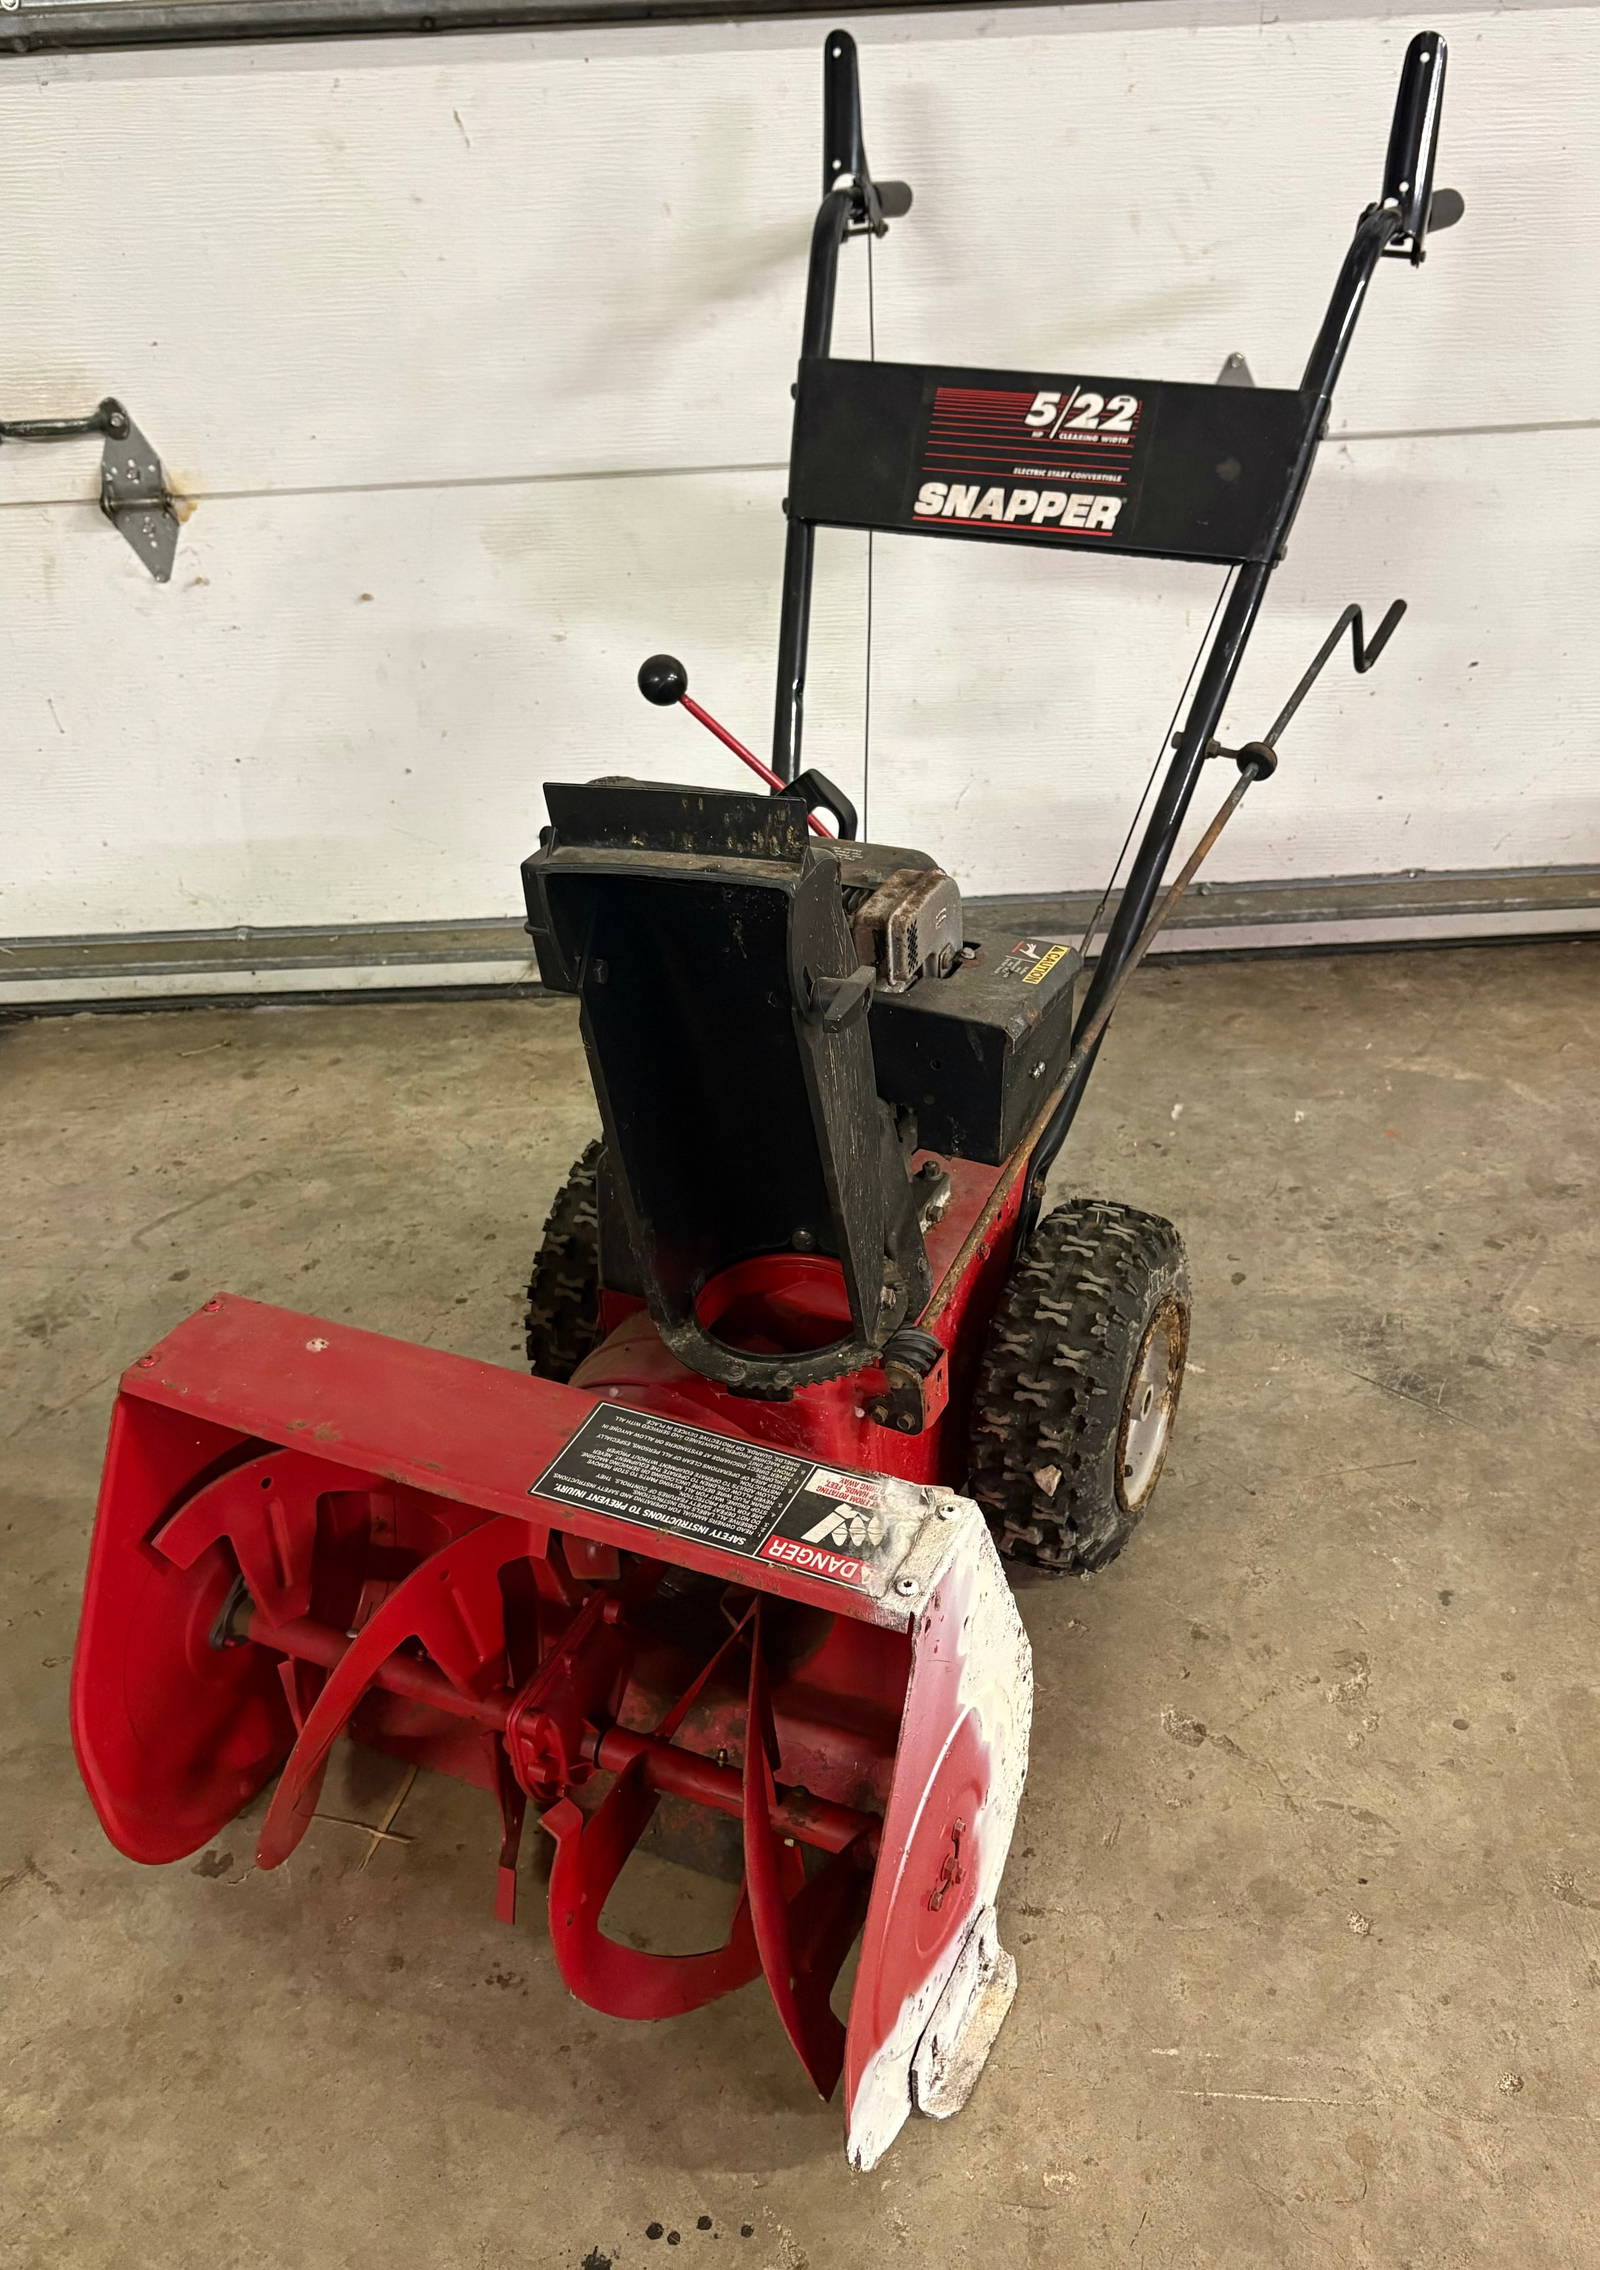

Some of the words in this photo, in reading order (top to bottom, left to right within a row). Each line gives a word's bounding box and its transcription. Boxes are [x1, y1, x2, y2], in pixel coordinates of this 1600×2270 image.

[1024, 384, 1138, 438] 5/22
[1058, 432, 1099, 442] CLEARING
[1101, 436, 1130, 444] WIDTH
[1013, 467, 1046, 476] ELECTRIC
[1047, 470, 1071, 478] START
[1070, 472, 1123, 482] CONVERTIBLE
[914, 482, 1122, 530] SNAPPER
[1026, 954, 1060, 982] CAUTION
[607, 1425, 634, 1436] ANYONE
[595, 1433, 631, 1446] ESPECIALLY
[632, 1432, 655, 1442] ALLOW
[591, 1449, 613, 1458] NEVER
[605, 1447, 631, 1457] PROPER
[663, 1441, 703, 1456] BYSTANDERS
[585, 1459, 612, 1469] REMOVE
[630, 1454, 659, 1465] WITHOUT
[680, 1457, 702, 1466] CLEAR
[710, 1455, 747, 1468] DISCHARGE
[657, 1462, 694, 1475] EQUIPMENT
[701, 1463, 740, 1477] OPERATIONS
[746, 1465, 770, 1475] DIRECT
[772, 1467, 794, 1476] FRONT
[637, 1474, 658, 1482] PARTS
[661, 1469, 690, 1480] OPERATE
[693, 1472, 722, 1483] OPERATE
[769, 1472, 791, 1481] NEVER
[657, 1480, 683, 1490] MOVING
[698, 1480, 731, 1492] CHILDREN
[749, 1477, 767, 1485] AREA
[767, 1482, 784, 1490] KEEP
[551, 1483, 587, 1497] INJURY.
[595, 1485, 620, 1495] SAFETY
[730, 1483, 756, 1493] ADULTS
[730, 1489, 753, 1498] ALLOW
[814, 1485, 849, 1500] ROTATING
[656, 1491, 689, 1503] FEATURES
[752, 1495, 774, 1505] NEVER
[755, 1490, 778, 1500] ALLOW
[584, 1492, 628, 1510] PREVENT
[632, 1496, 667, 1509] OPERATING
[688, 1500, 712, 1510] SAFETY
[848, 1496, 870, 1506] FROM
[627, 1505, 642, 1514] TO
[690, 1506, 715, 1517] LABELS
[712, 1507, 736, 1517] DEFEAT
[718, 1503, 736, 1511] YOUR
[749, 1506, 767, 1514] STOP
[681, 1510, 708, 1521] MANUAL
[640, 1509, 709, 1534] INSTRUCTIONS
[727, 1517, 757, 1529] OBSERVE
[735, 1526, 754, 1534] READ
[708, 1528, 746, 1545] SAFETY
[767, 1540, 859, 1577] DANGER
